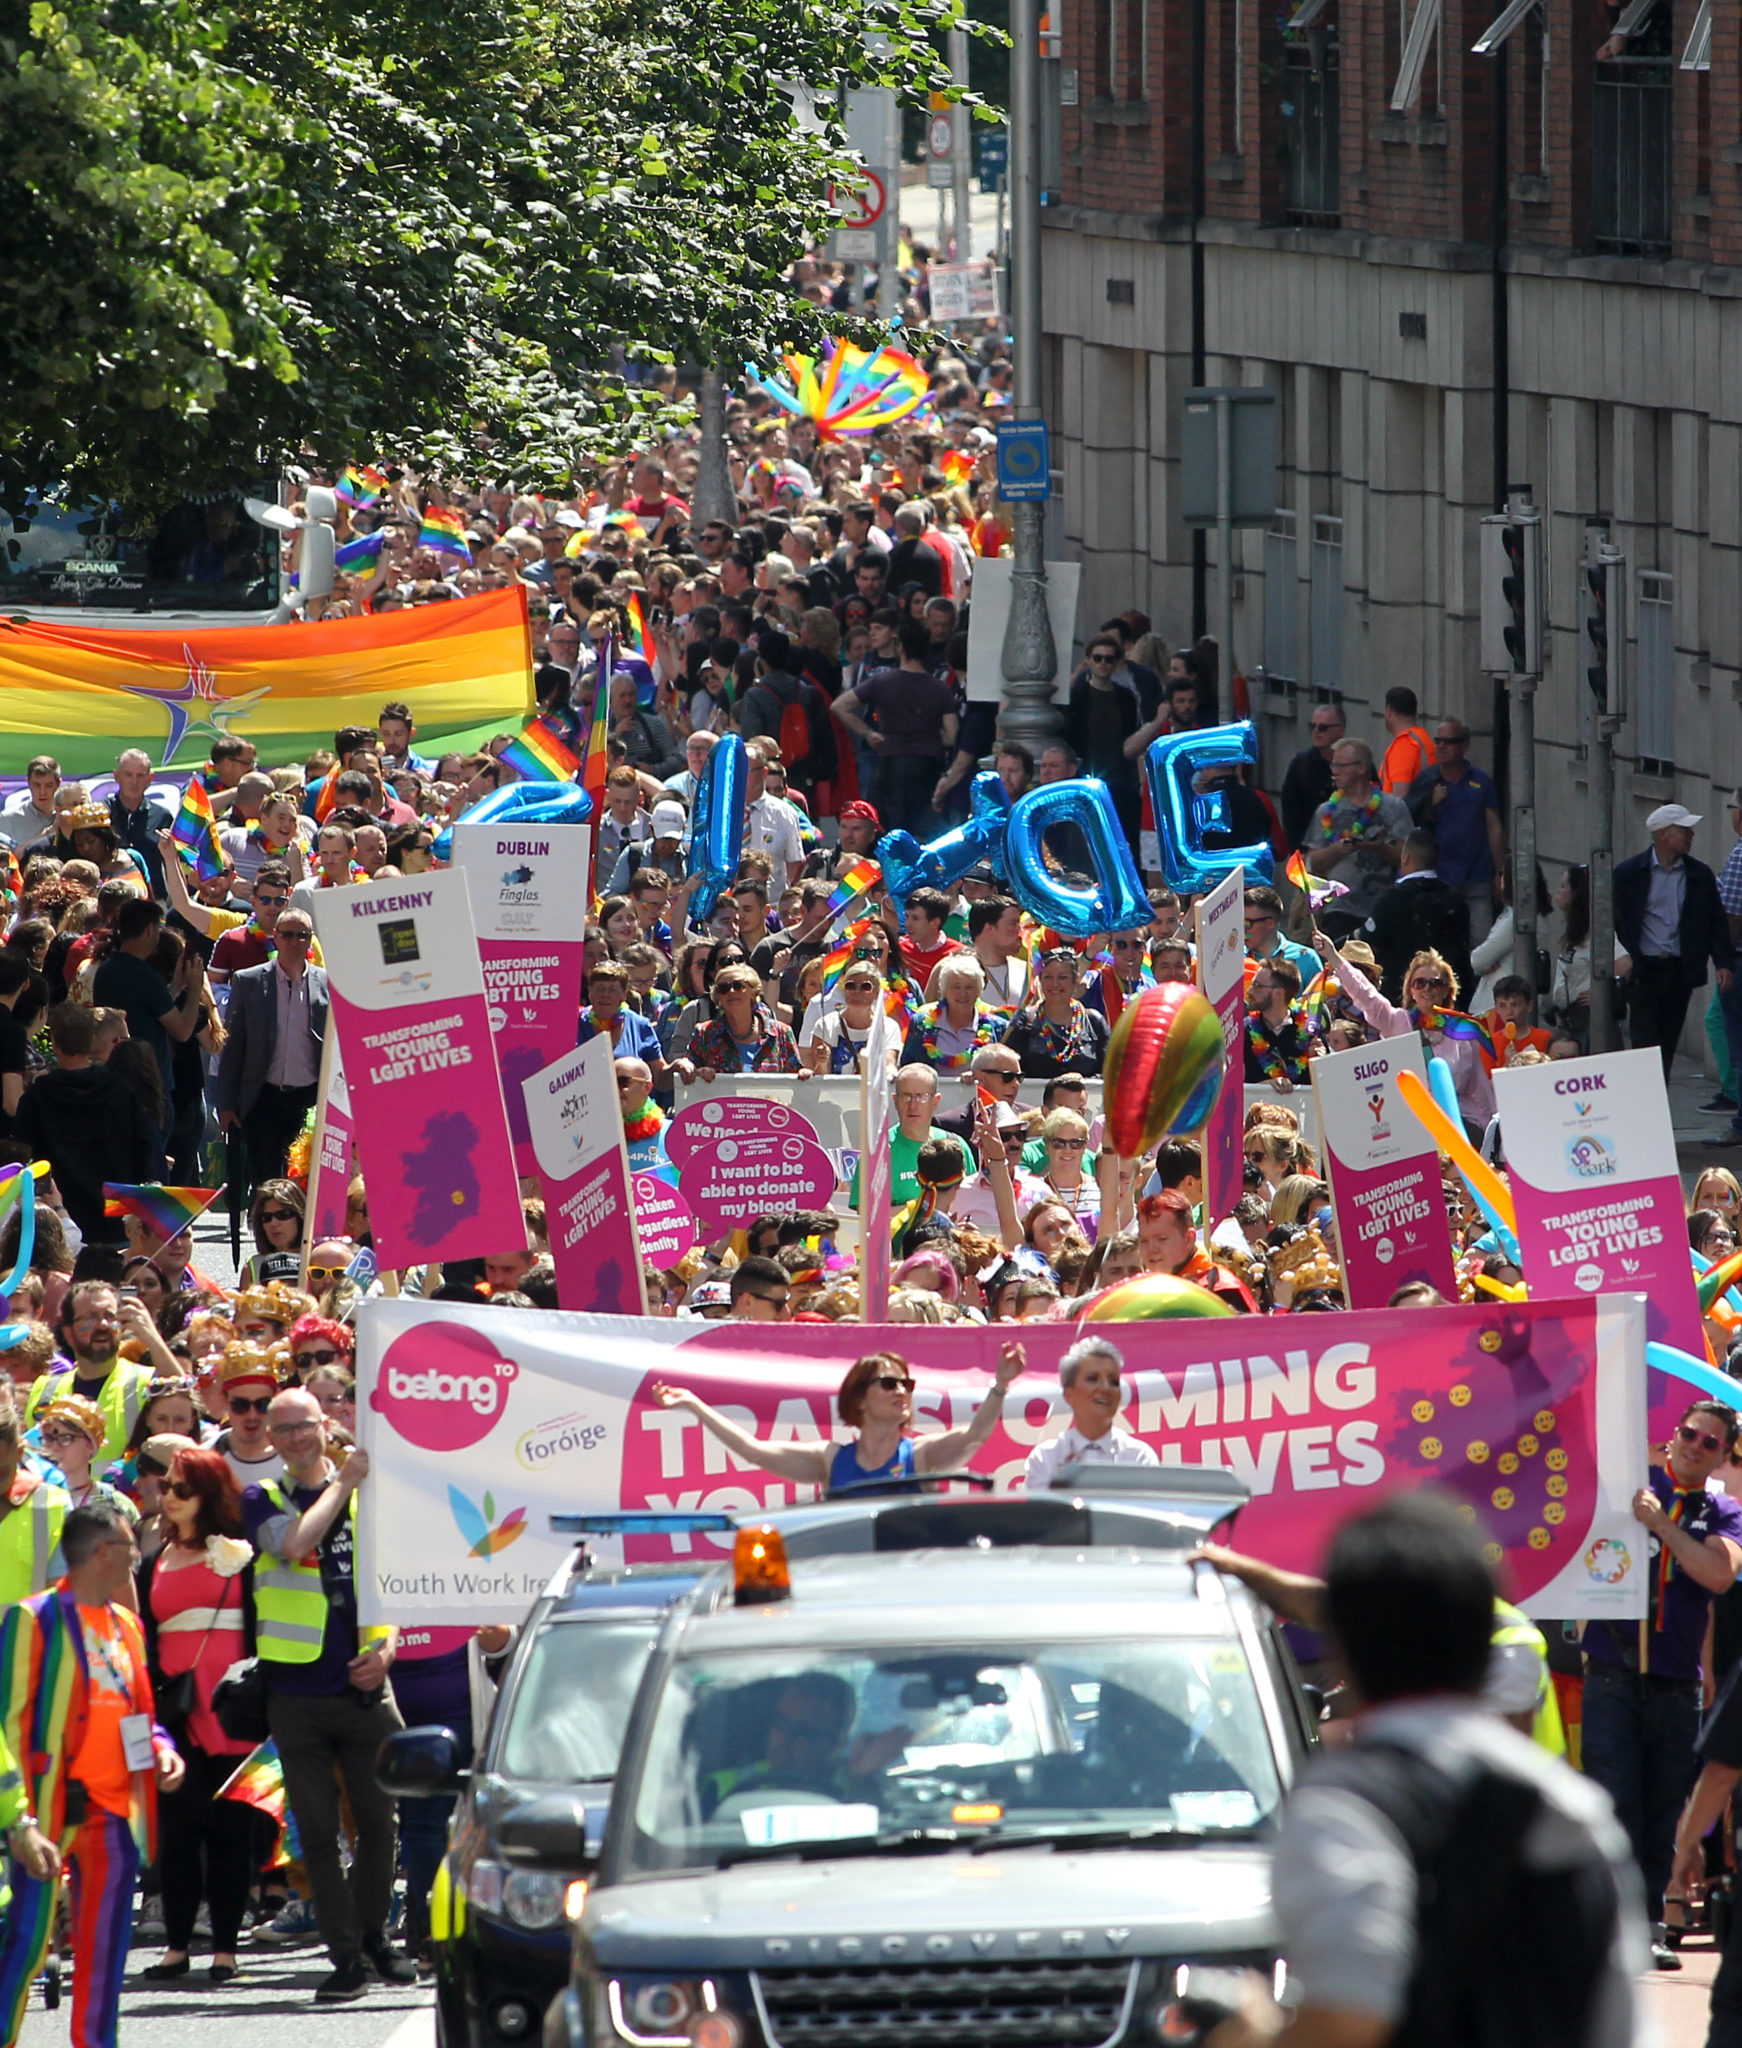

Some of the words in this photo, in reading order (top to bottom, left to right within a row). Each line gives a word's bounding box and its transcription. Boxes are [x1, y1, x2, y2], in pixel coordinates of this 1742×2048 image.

[65, 560, 119, 574] SCANIA
[496, 841, 549, 856] DUBLIN
[351, 890, 433, 917] KILKENNY
[499, 888, 539, 903] Finglas
[482, 956, 560, 970] ANSFORMING
[486, 969, 543, 987] YOUNG
[487, 987, 511, 1003] BT
[514, 984, 560, 1002] LIVES
[362, 1014, 464, 1048] TRANSFORMING
[383, 1032, 450, 1061] YOUNG
[370, 1058, 416, 1085] LGBT
[420, 1045, 472, 1072] LIVES
[1354, 1058, 1389, 1081] SLIGO
[549, 1061, 586, 1094] GALWAY
[1554, 1074, 1607, 1095] CORK
[684, 1122, 711, 1138] We
[629, 1152, 666, 1164] 4Pride
[711, 1166, 717, 1179] I
[720, 1165, 762, 1179] want
[763, 1164, 781, 1177] to
[781, 1162, 804, 1176] be
[559, 1168, 611, 1217] TRANSFORMING
[700, 1184, 738, 1198] able
[739, 1184, 756, 1197] to
[757, 1179, 815, 1195] donate
[1353, 1171, 1424, 1207] TRANSFORMING
[570, 1187, 605, 1224] YOUNG
[645, 1198, 676, 1214] taken
[720, 1204, 745, 1218] my
[748, 1198, 797, 1214] blood
[1368, 1188, 1415, 1219] YOUNG
[1542, 1195, 1655, 1231] TRANSFORMING
[564, 1220, 590, 1249] LGBT
[591, 1195, 617, 1227] LIVES
[637, 1216, 690, 1237] egardless
[1358, 1215, 1392, 1241] LGBT
[1393, 1200, 1431, 1228] LIVES
[1566, 1214, 1639, 1244] YOUNG
[640, 1236, 679, 1254] dentity
[1549, 1239, 1601, 1267] LGBT
[1605, 1225, 1664, 1255] LIVES
[388, 1368, 498, 1415] belong
[494, 1363, 515, 1378] TO
[524, 1422, 607, 1463] foróige
[379, 1572, 445, 1595] Youth
[453, 1572, 514, 1595] Work
[407, 1632, 431, 1646] me
[765, 1926, 1131, 1957] DISCOVERY
